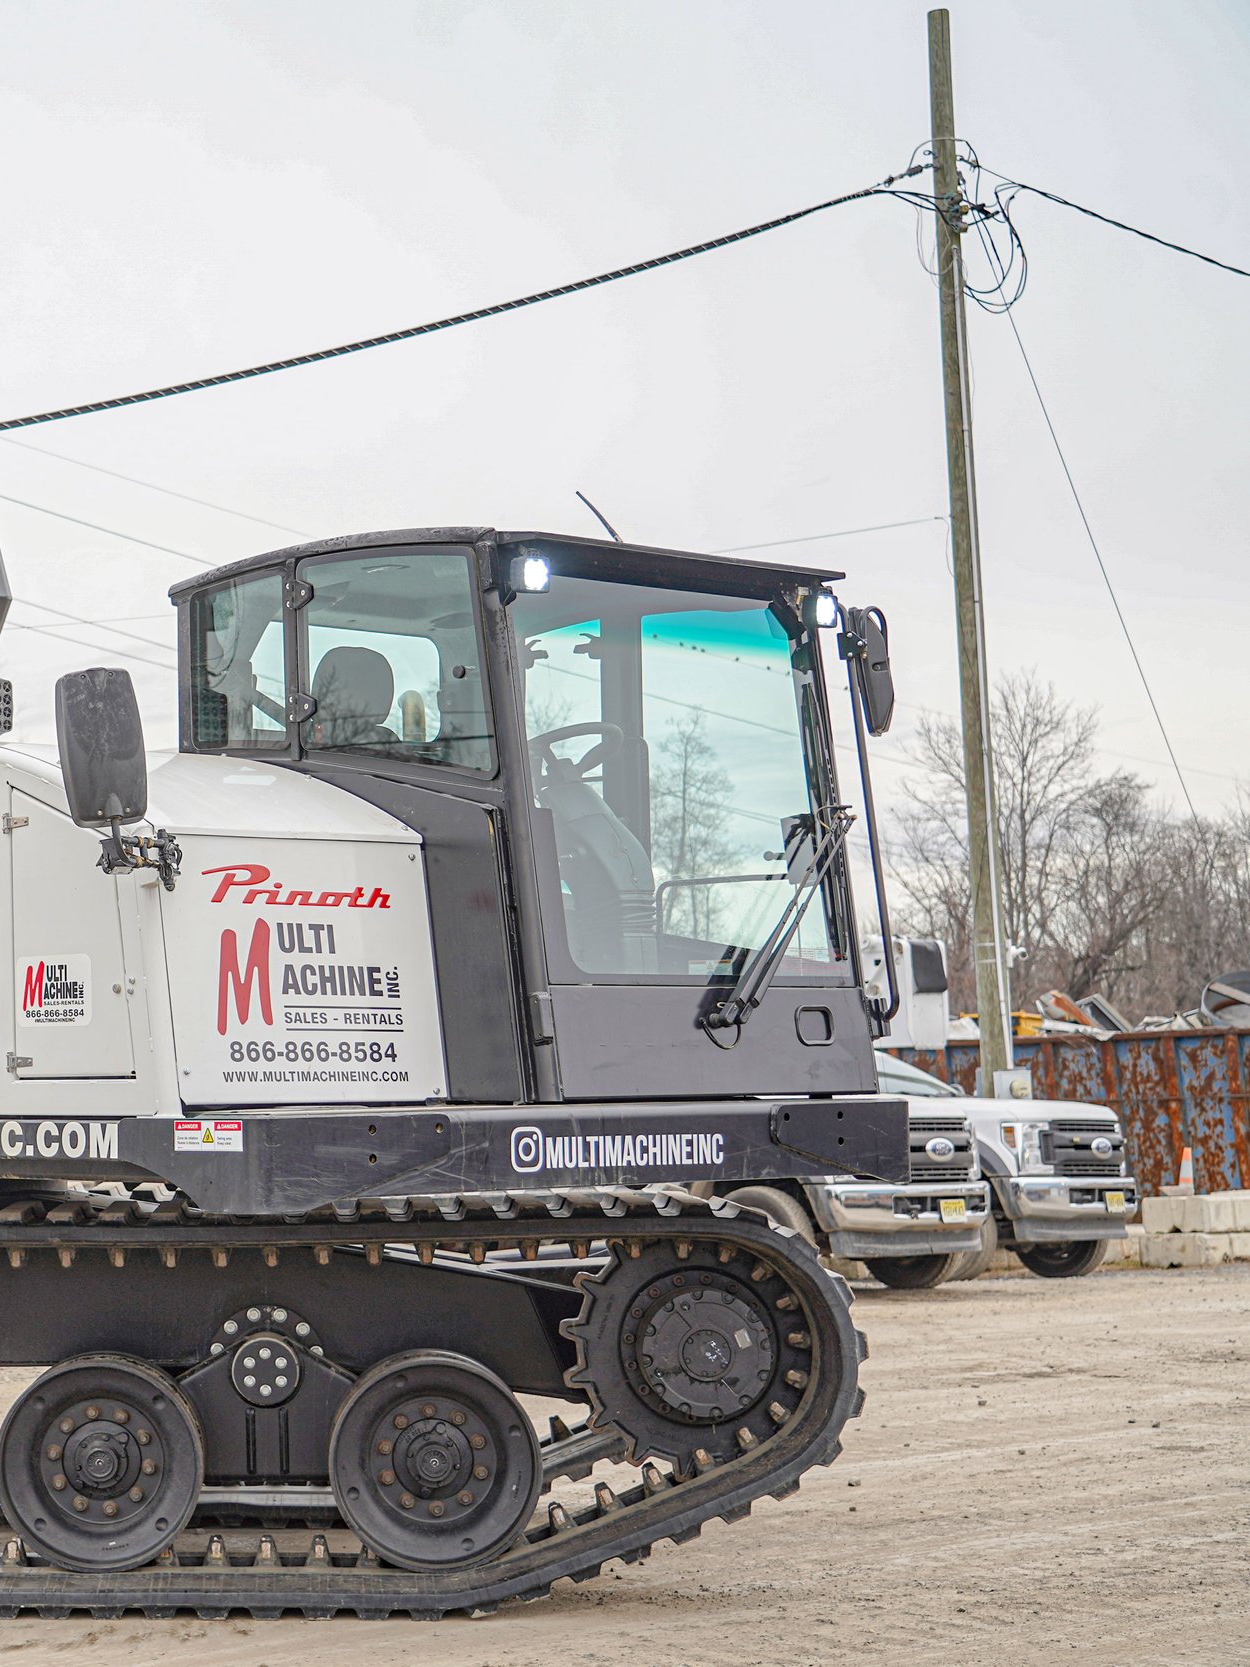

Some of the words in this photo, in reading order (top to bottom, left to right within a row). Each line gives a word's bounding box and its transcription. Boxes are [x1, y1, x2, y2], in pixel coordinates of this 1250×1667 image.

[201, 864, 391, 909] Prinoth
[385, 966, 401, 999] INC.
[25, 1008, 84, 1018] 866-866-8584
[284, 1011, 328, 1025] SALES
[344, 1012, 404, 1026] RENTALS
[229, 1040, 398, 1063] 866-866-8584
[222, 1070, 410, 1083] WWW.MULTIMACHINEINC.COM
[545, 1133, 724, 1169] MULTIMACHINEINC
